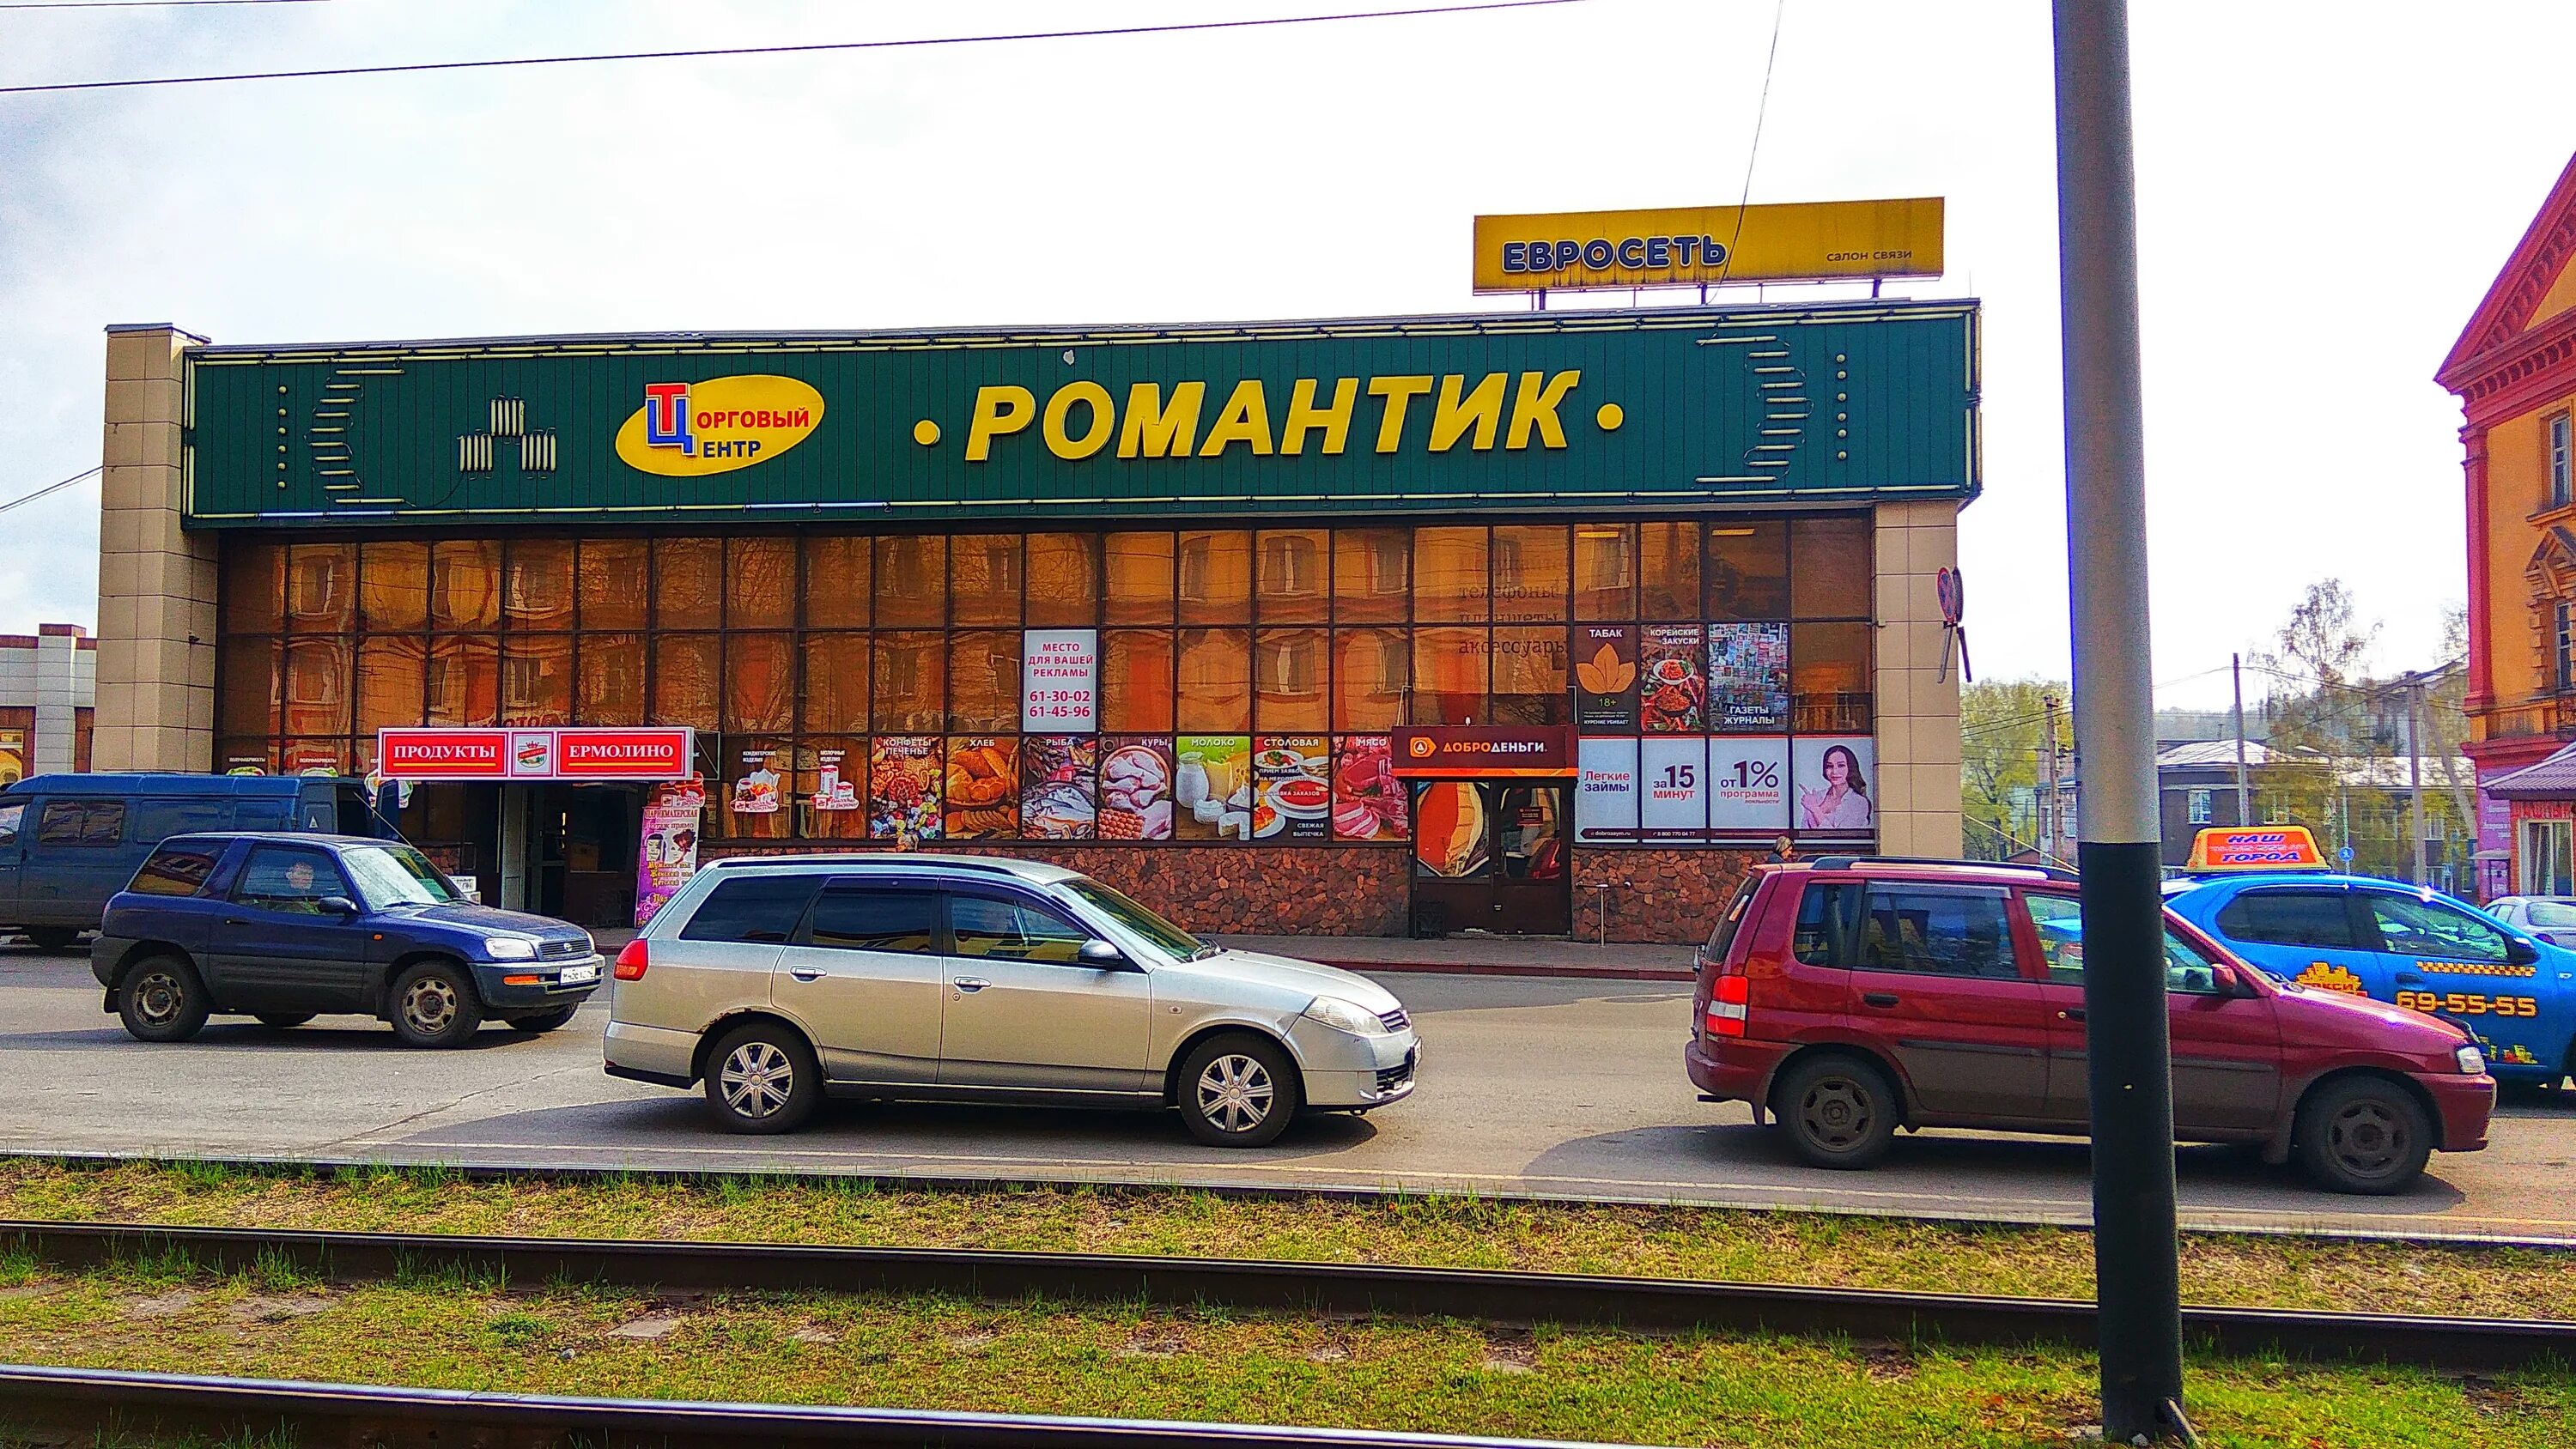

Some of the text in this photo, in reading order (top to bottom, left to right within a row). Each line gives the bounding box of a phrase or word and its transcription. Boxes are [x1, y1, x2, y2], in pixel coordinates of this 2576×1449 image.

[1503, 234, 1727, 272] ЕВРОСЕТЬ
[1826, 251, 1912, 261] салон связи
[965, 369, 1581, 461] РОМАНТИК
[1457, 585, 1555, 603] телефоны
[1650, 627, 1699, 636] КОРЕЙСКИЕ
[1042, 643, 1080, 652] МЕСТО
[1028, 654, 1093, 666] ДЛЯ ВАШЕЙ
[1033, 669, 1088, 677] РЕКЛАМЫ
[1030, 690, 1091, 702] 61-30-02
[1599, 698, 1617, 706] 18+
[1030, 706, 1091, 718] 61-45-96
[1724, 716, 1775, 724] ЖУРНАЛЫ
[883, 738, 932, 747] КОНФЕТЫ
[969, 738, 995, 747] ХЛЕБ
[1046, 738, 1073, 747] РЫБА
[1141, 738, 1168, 747] КУРЫ
[1191, 738, 1236, 747] МОЛОКО
[1358, 738, 1387, 747] МЯСО
[393, 744, 495, 759] ПРОДУКТЫ
[568, 744, 673, 757] ЕРМОЛИНО
[885, 747, 928, 755] ПЕЧЕНЬЕ
[1584, 771, 1630, 780] Легкие
[1665, 765, 1695, 788] 15
[1721, 761, 1778, 788] от 1%
[1584, 782, 1630, 791] займы
[1653, 791, 1695, 800] минут
[645, 809, 698, 818] ПАРИКМАХЕРСКАЯ
[2222, 852, 2300, 862] ГОРОД
[2396, 991, 2537, 1017] 69-55-55
